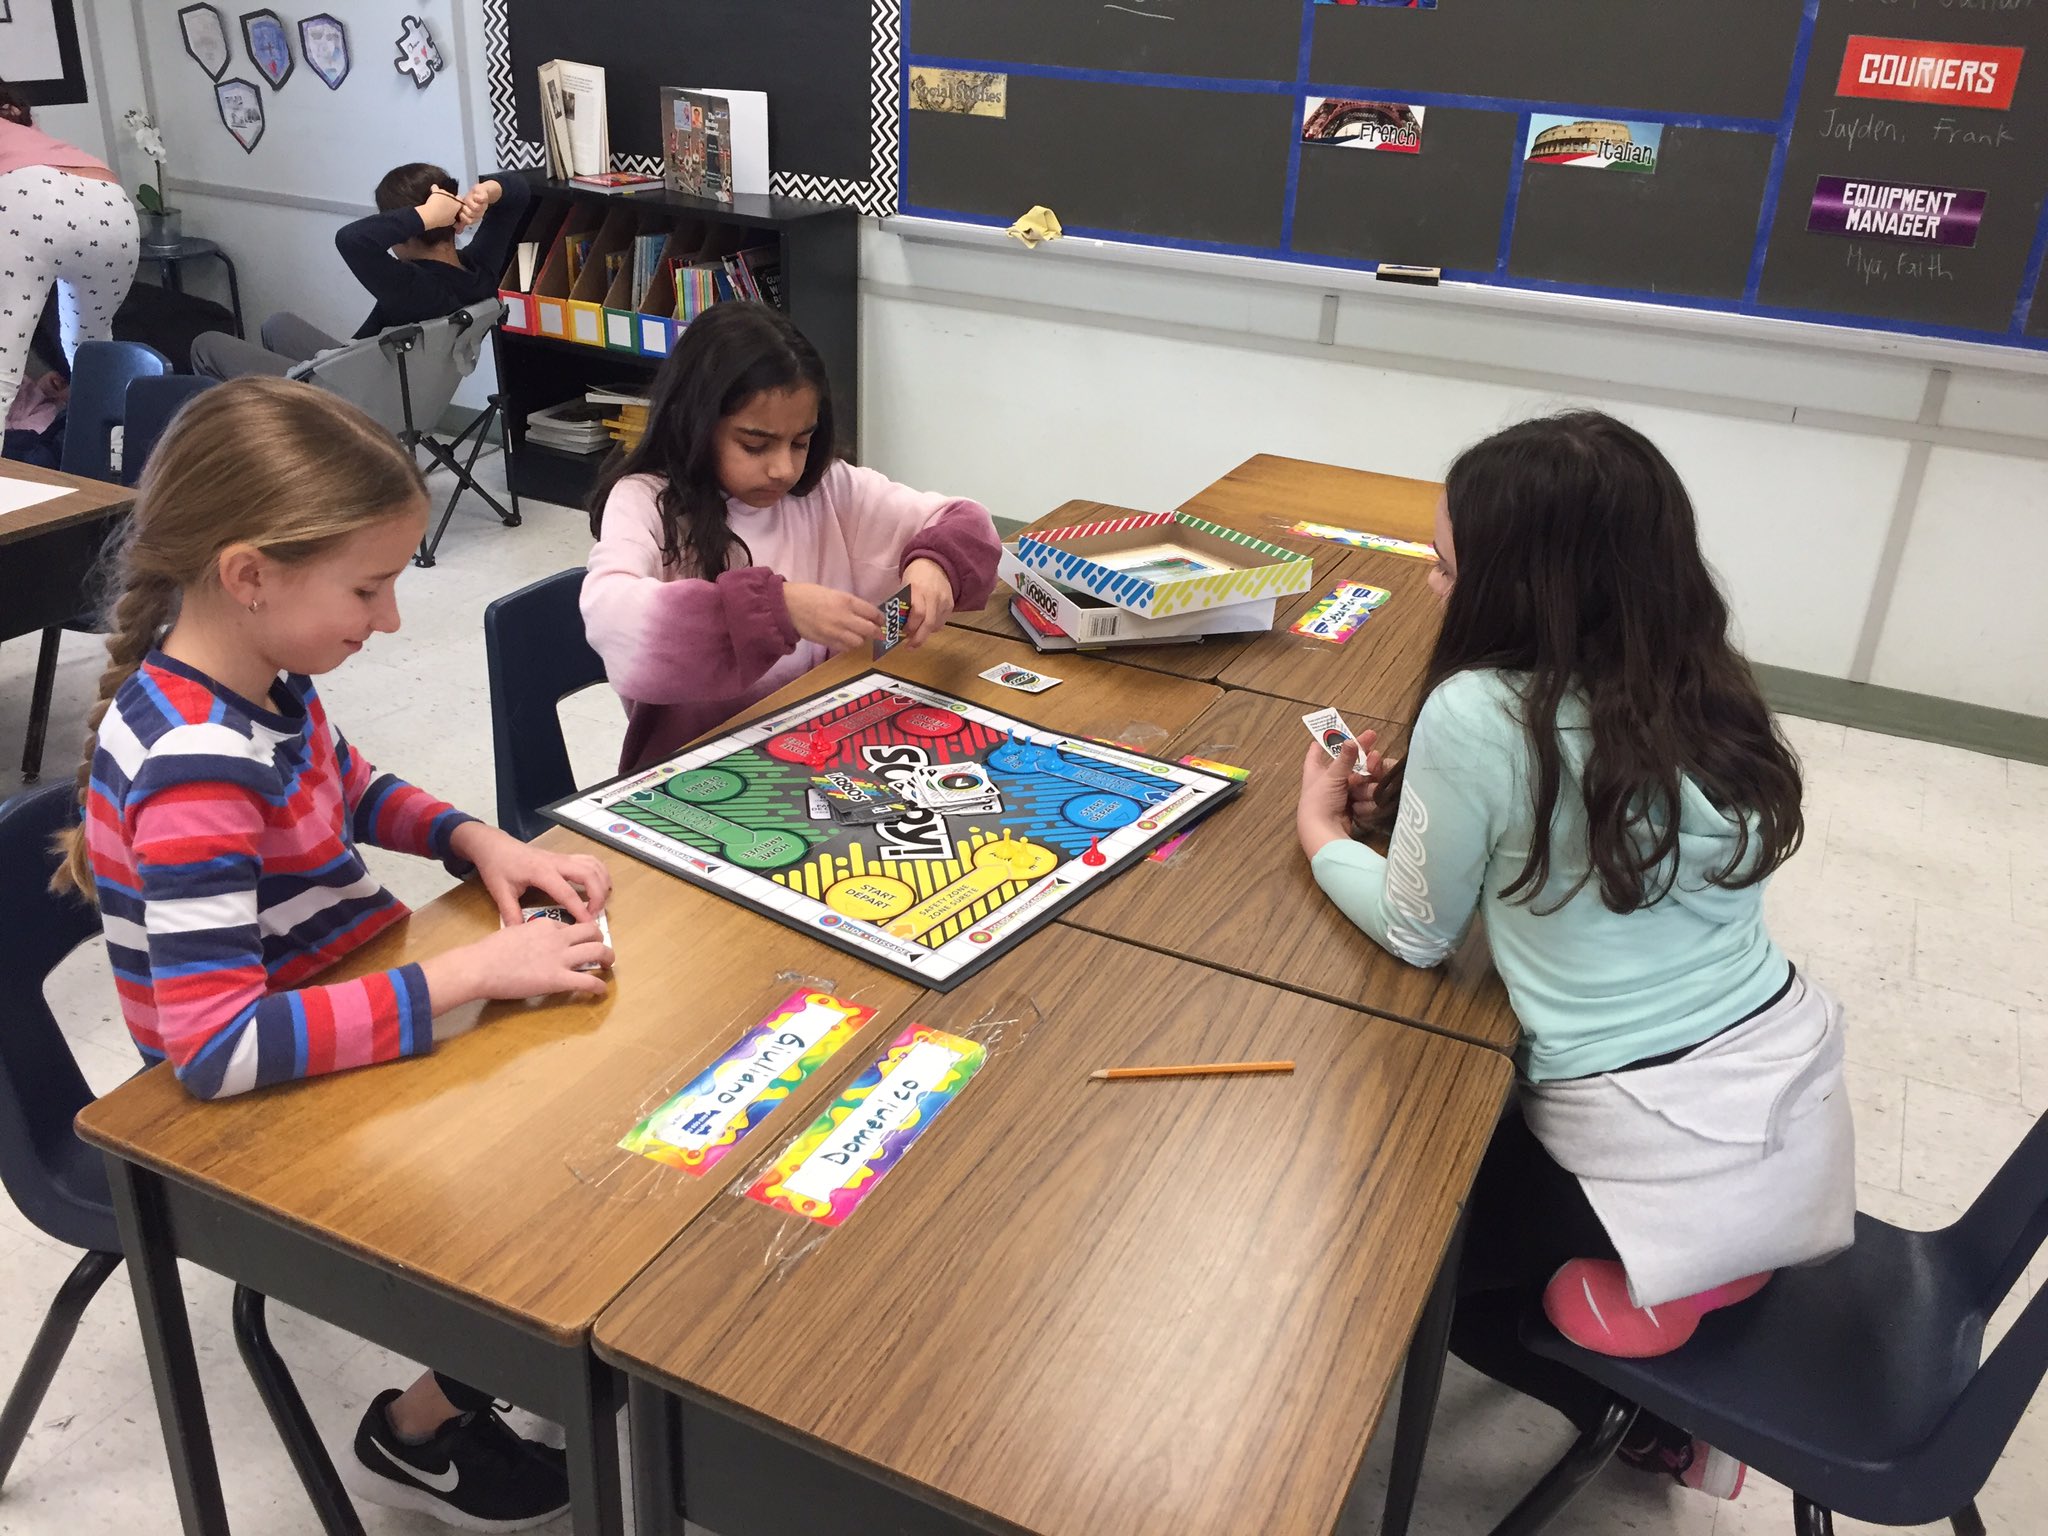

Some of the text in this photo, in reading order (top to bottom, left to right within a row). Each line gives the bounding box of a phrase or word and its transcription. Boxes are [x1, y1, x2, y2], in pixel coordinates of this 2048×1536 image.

[1859, 54, 1998, 94] COURIERS
[1359, 122, 1419, 146] French
[1934, 117, 2015, 147] Frank
[1597, 139, 1654, 165] Italian
[1842, 183, 1957, 216] EQUIPMENT
[1845, 208, 1941, 239] MANAGER
[1897, 252, 1953, 280] Faith
[825, 772, 873, 803] SORRY!
[1080, 799, 1106, 817] START
[759, 842, 790, 861] HOME
[861, 884, 896, 901] START
[918, 884, 970, 916] SAFETY ZONE
[928, 905, 951, 919] ZONE
[841, 923, 864, 937] SLIDE
[717, 1032, 806, 1104] Giuliano
[820, 1078, 919, 1165] Domenico
